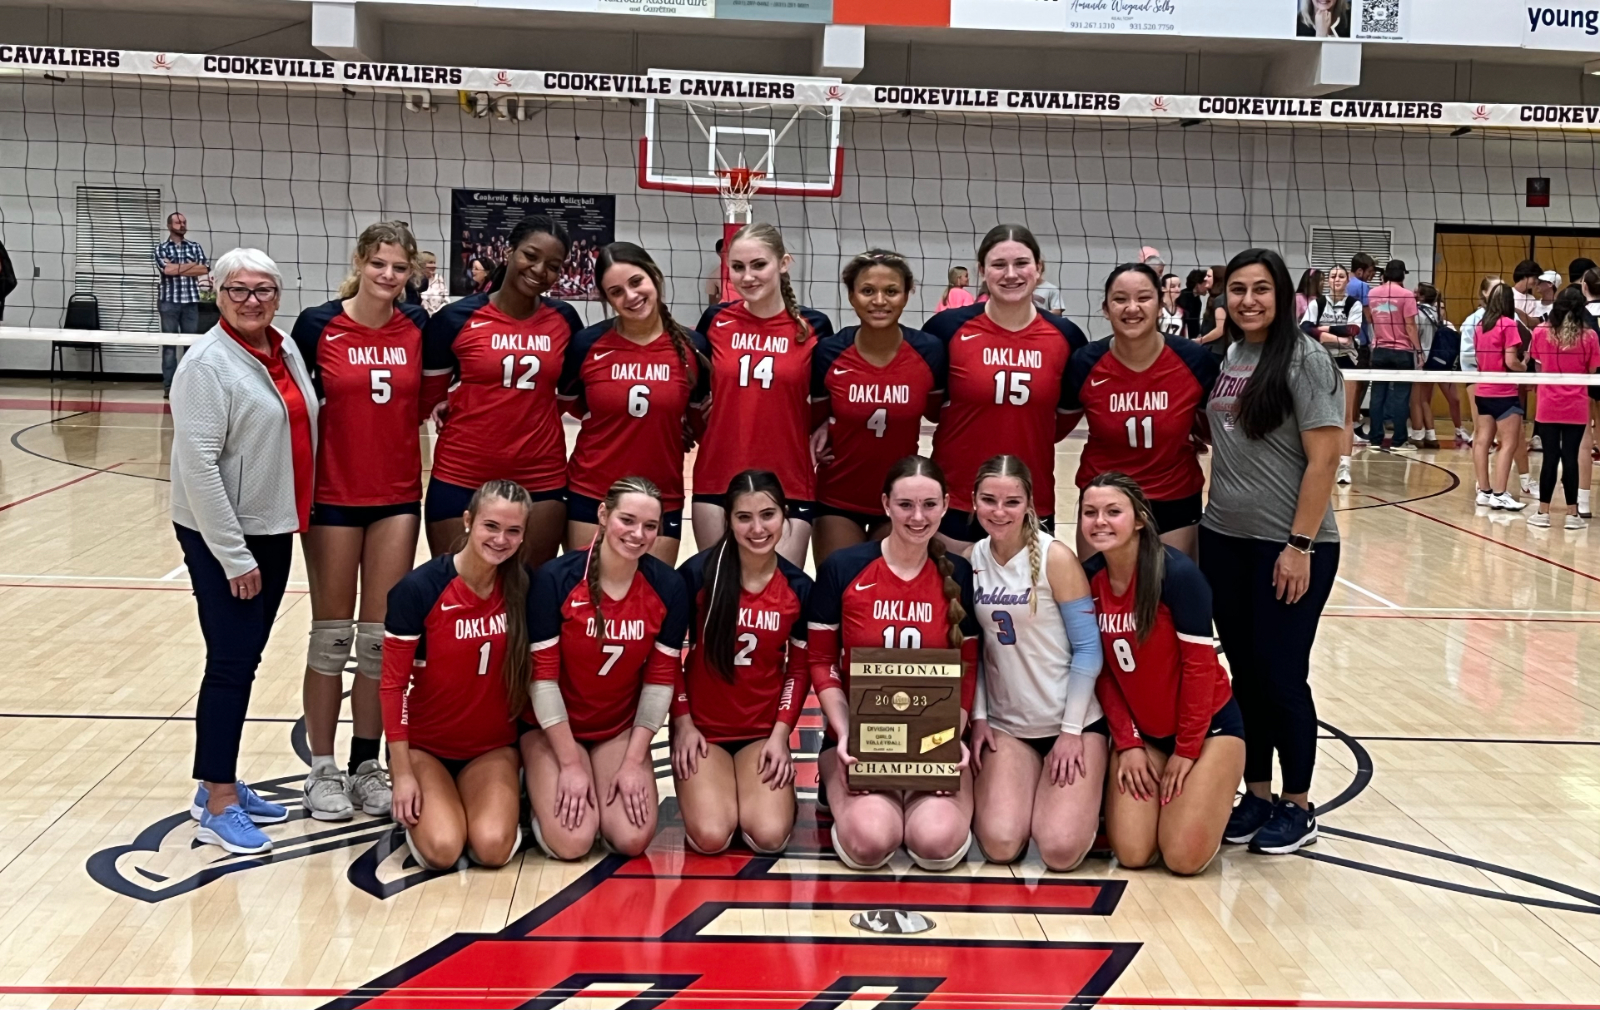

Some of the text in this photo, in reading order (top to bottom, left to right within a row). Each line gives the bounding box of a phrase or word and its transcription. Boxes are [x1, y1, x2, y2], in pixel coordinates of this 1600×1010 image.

[1527, 7, 1599, 35] young
[0, 46, 120, 68] CAVALIERS
[203, 56, 462, 85] COOKEVILLE CAVALIERS
[544, 72, 795, 99] COOKEVILLE CAVALIERS
[874, 86, 1121, 111] COOKEVILLE CAVALIERS
[1198, 97, 1443, 119] COOKEVILLE CAVALIERS
[1520, 105, 1600, 124] COOKEV
[491, 334, 551, 352] OAKLAND
[731, 332, 789, 354] OAKLAND
[348, 346, 407, 366] OAKLAND
[983, 347, 1042, 369] OAKLAND
[502, 354, 541, 390] 12
[611, 363, 670, 382] OAKLAND
[739, 354, 774, 389] 14
[371, 369, 391, 404] 5
[849, 384, 909, 404] OAKLAND
[994, 371, 1032, 406] 15
[628, 384, 650, 418] 6
[1109, 391, 1168, 413] OAKLAND
[867, 408, 887, 438] 4
[1125, 416, 1153, 449] 11
[974, 586, 1032, 606] Oakland
[738, 607, 781, 632] KLAND
[873, 599, 932, 623] OAKLAND
[455, 612, 508, 640] OAKLAN
[586, 617, 645, 640] OKLAND
[882, 626, 922, 649] 10
[991, 610, 1017, 646] 3
[477, 641, 491, 676] 1
[597, 645, 625, 676] 7
[733, 633, 758, 666] 2
[1112, 638, 1136, 673] 8
[862, 664, 950, 676] REGIONAL
[875, 694, 889, 706] 20
[912, 695, 928, 706] 23
[854, 763, 956, 775] CHAMPIONS
